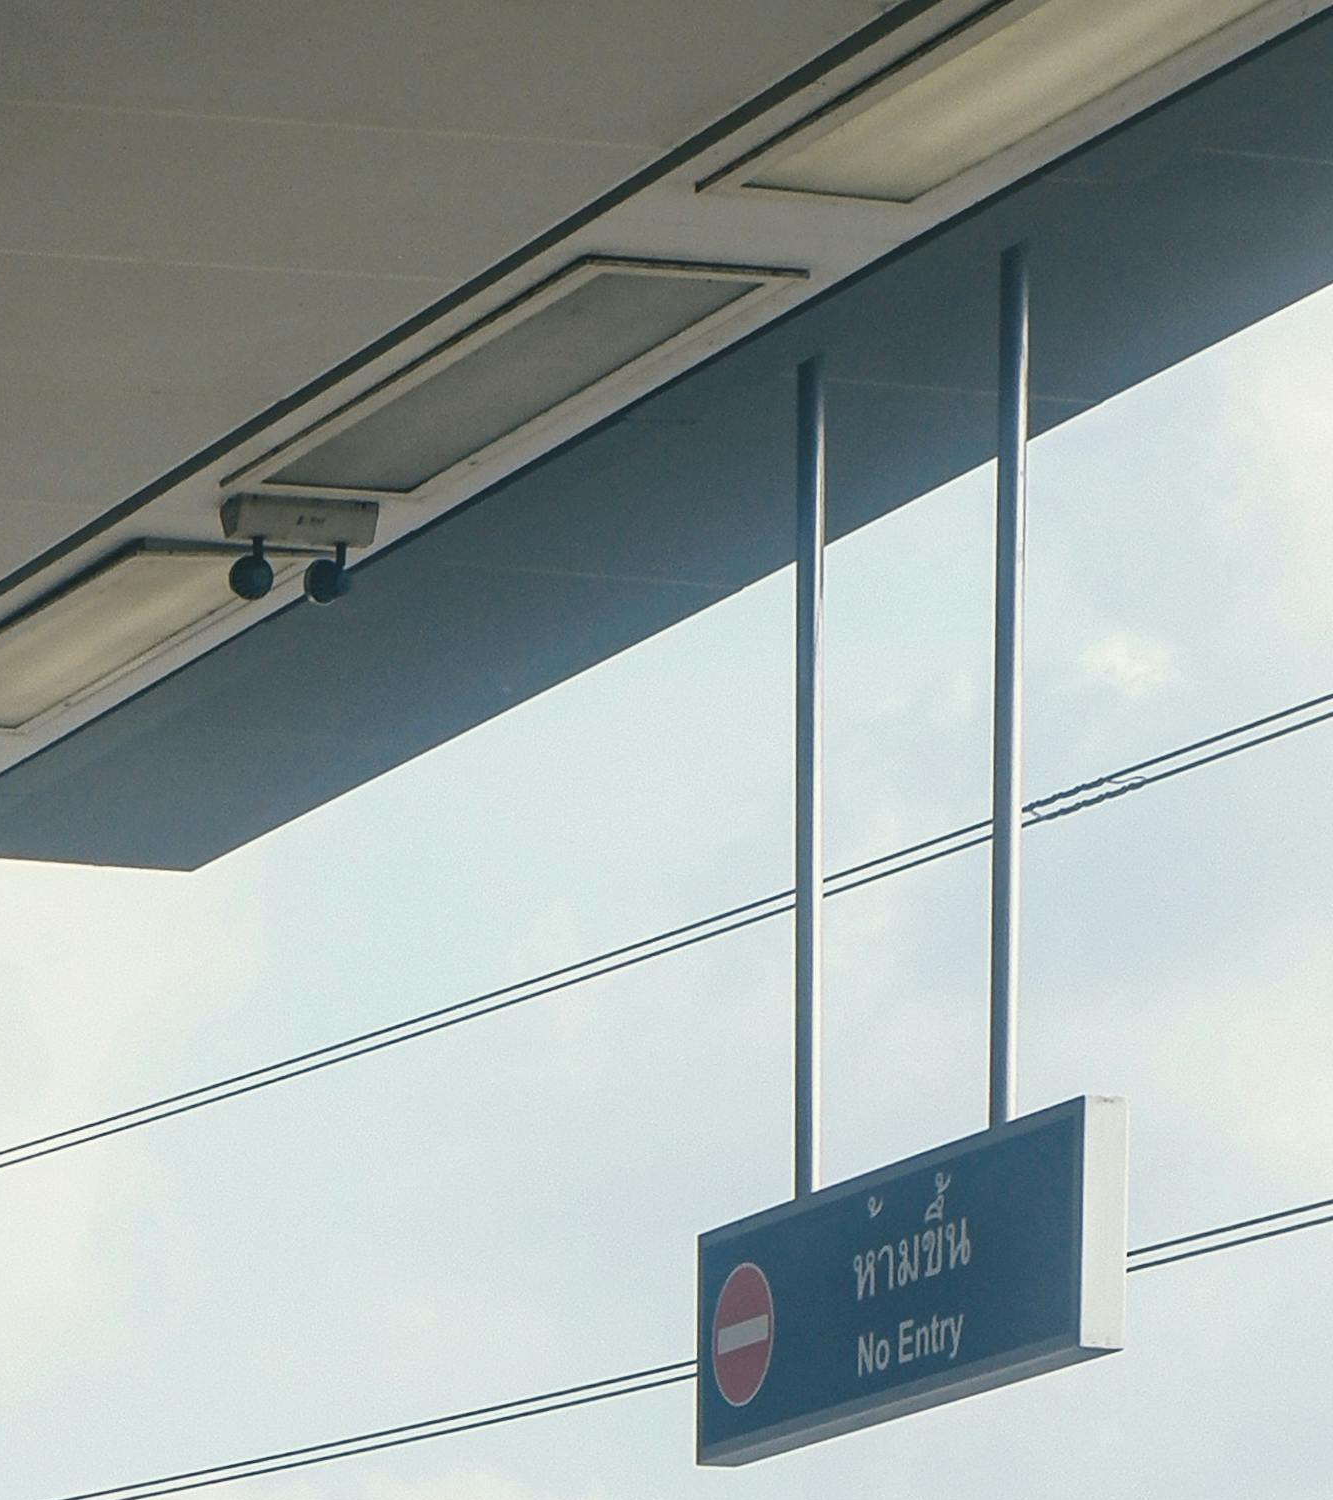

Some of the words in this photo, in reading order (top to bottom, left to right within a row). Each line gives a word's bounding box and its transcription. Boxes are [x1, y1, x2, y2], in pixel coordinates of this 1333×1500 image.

[853, 1172, 971, 1300] ห้ามขึ้น
[858, 1332, 890, 1377] No
[898, 1313, 964, 1364] Entry
